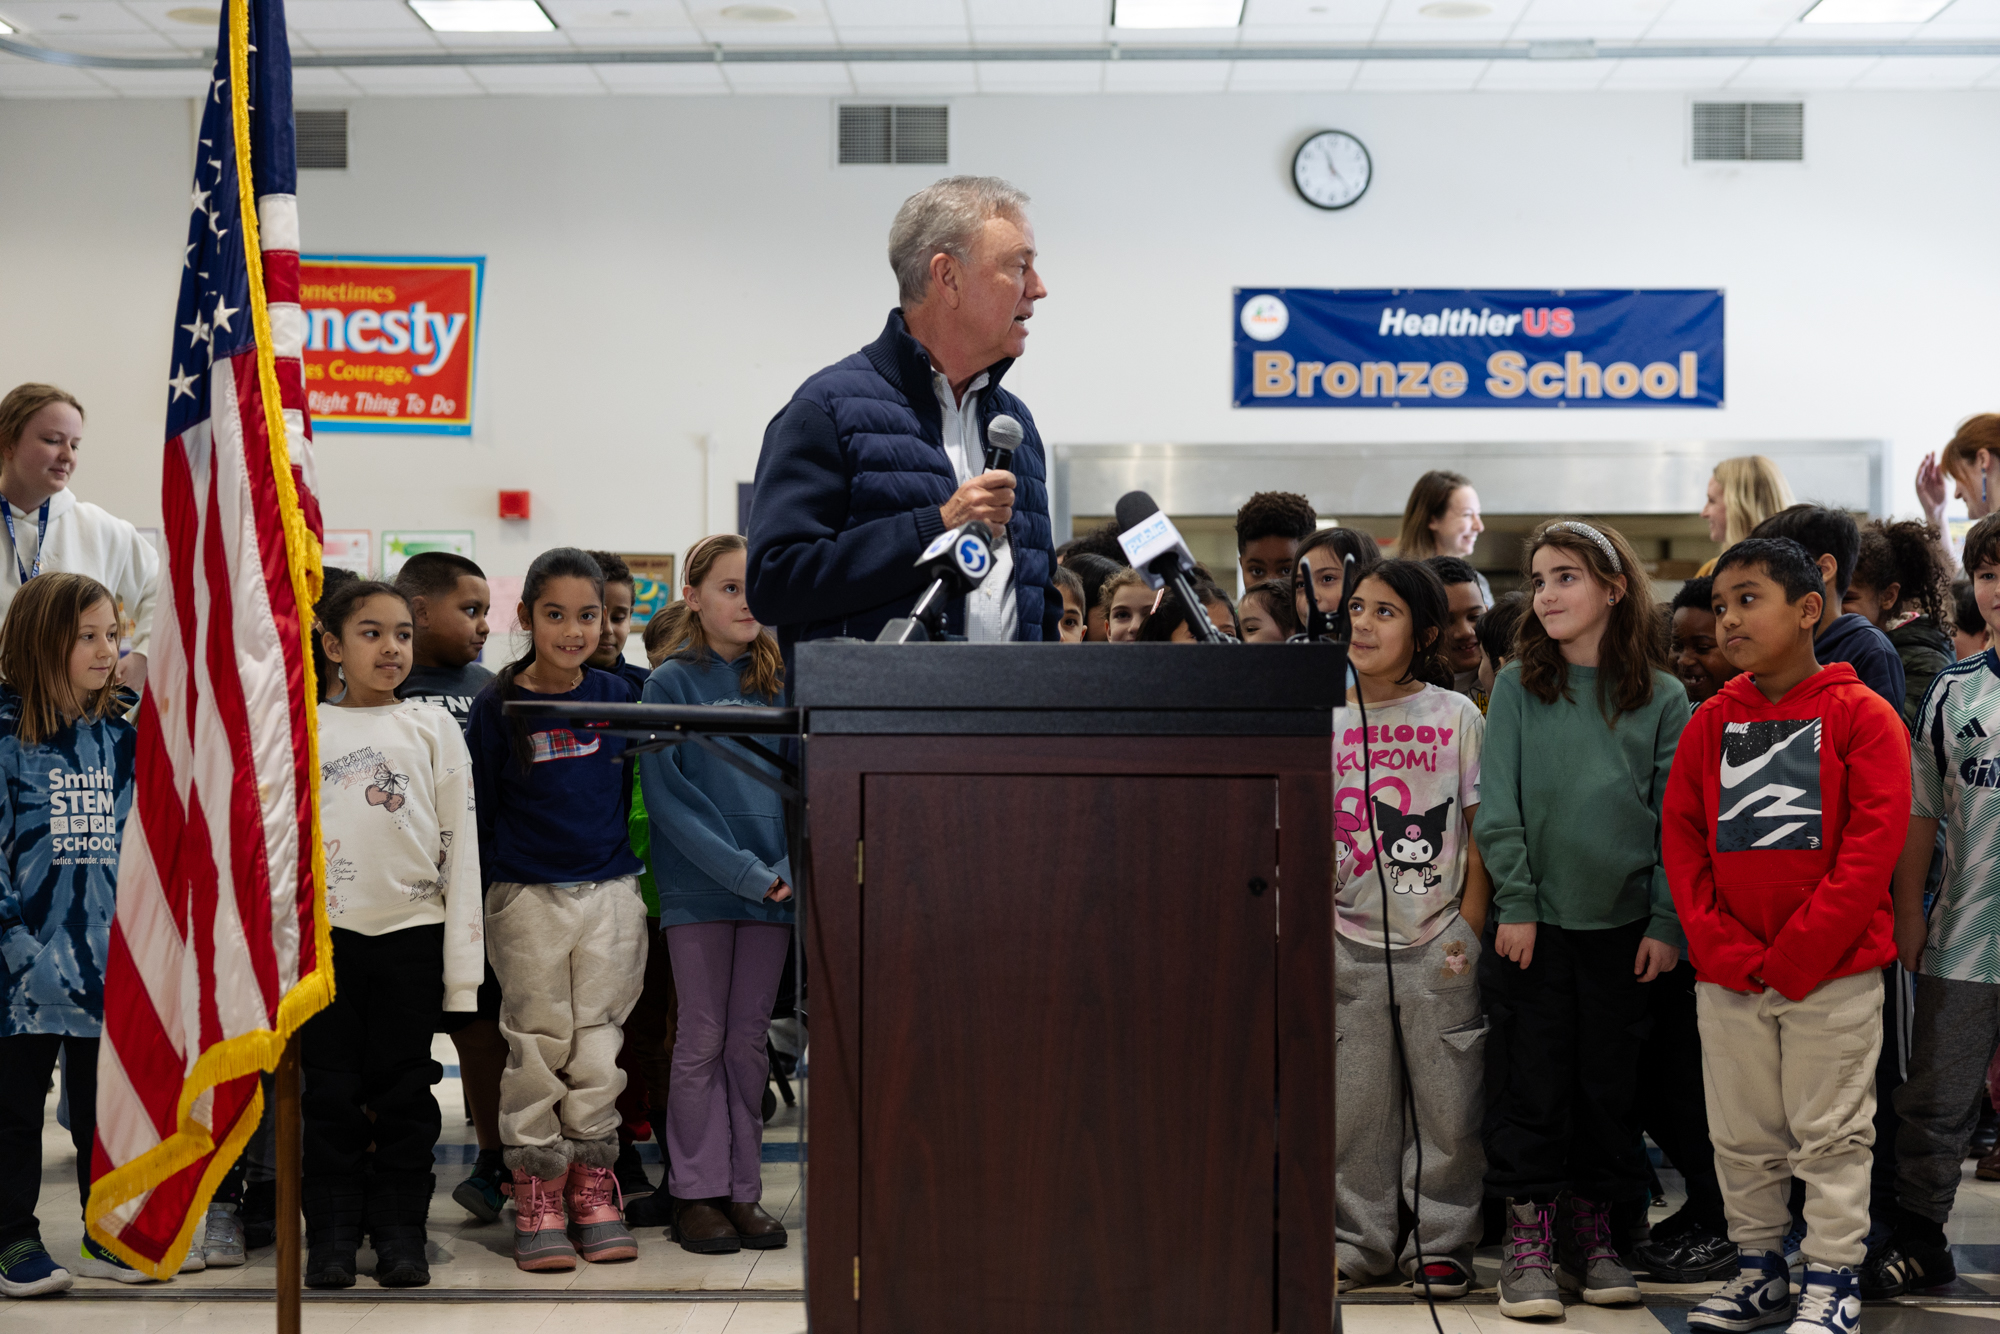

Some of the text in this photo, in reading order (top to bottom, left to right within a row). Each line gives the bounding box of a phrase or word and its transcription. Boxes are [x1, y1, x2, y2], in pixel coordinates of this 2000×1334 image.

[300, 282, 396, 304] ometimes
[328, 360, 412, 385] Courage,
[1253, 351, 1698, 399] Bronze School
[308, 390, 456, 417] Right Thing To Do
[1343, 724, 1453, 746] MELODY
[1725, 721, 1750, 734] NIKE
[48, 766, 114, 790] Smith
[50, 790, 115, 815] STEM
[52, 836, 117, 852] SCHOOL
